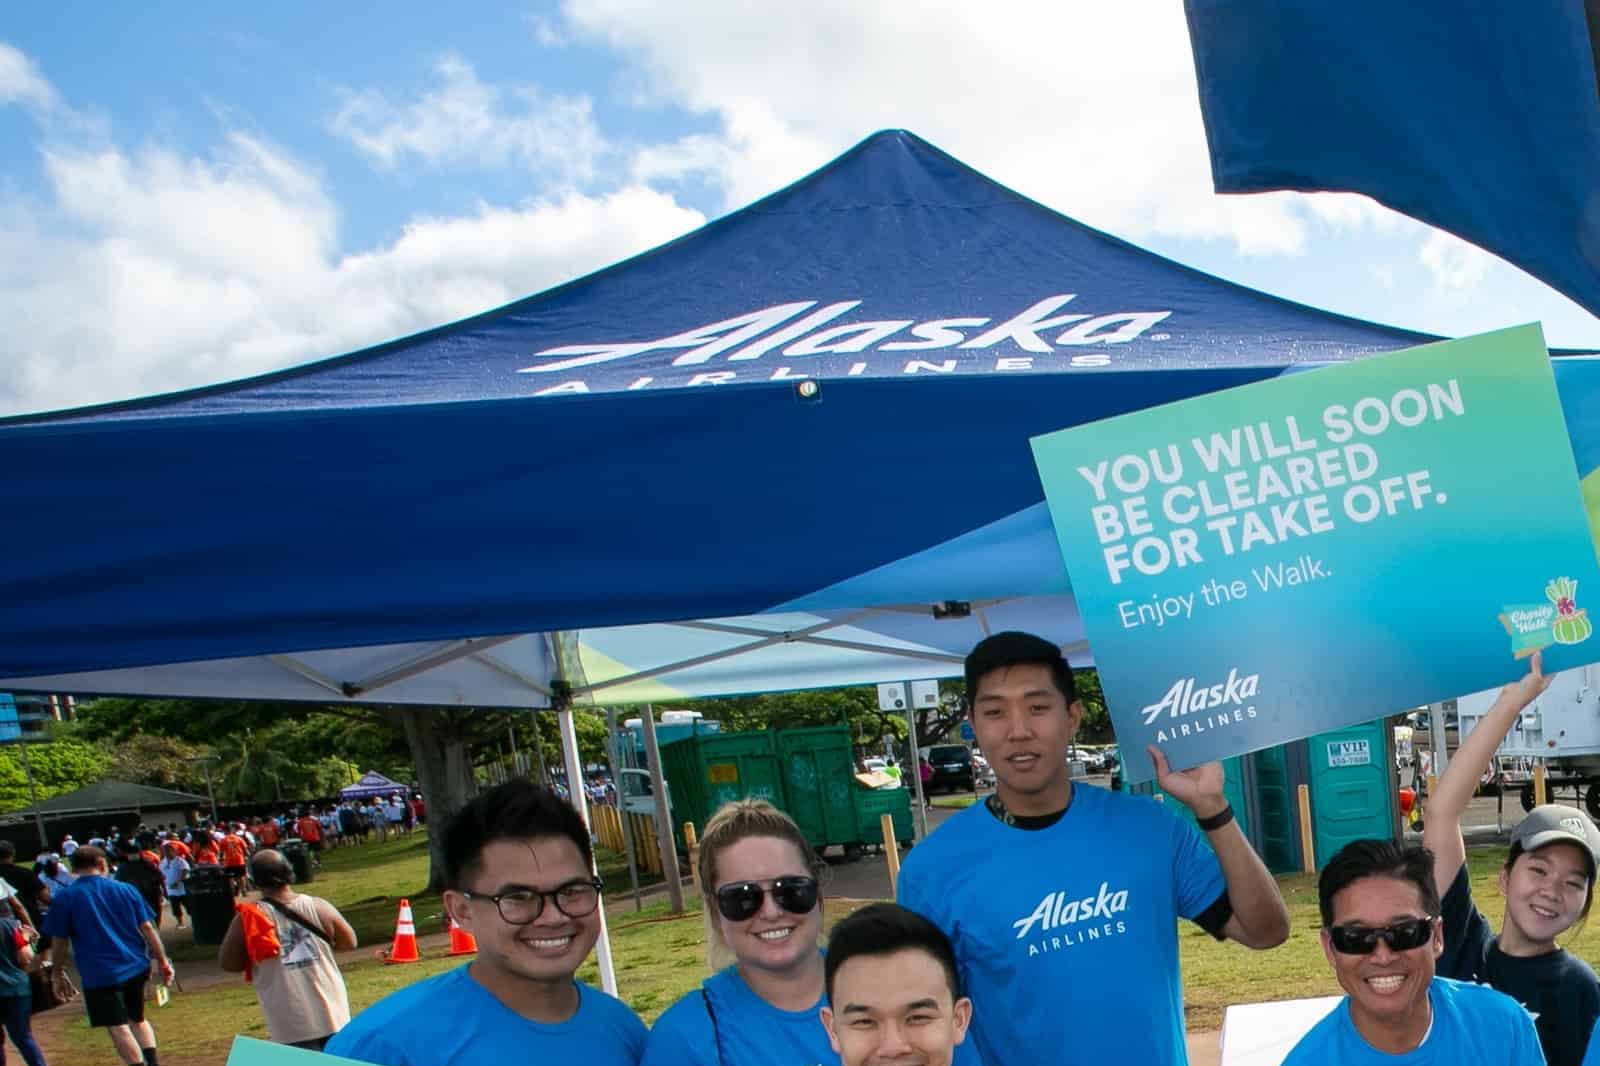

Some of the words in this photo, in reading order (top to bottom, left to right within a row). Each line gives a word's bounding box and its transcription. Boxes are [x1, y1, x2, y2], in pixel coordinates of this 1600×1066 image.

[516, 294, 1172, 373] Alaska
[533, 353, 1112, 397] AIRLINES
[1077, 444, 1183, 501] YOU
[1191, 415, 1316, 472] WILL
[1323, 379, 1465, 442] SOON
[1091, 496, 1153, 545] BE
[1162, 443, 1378, 524] CLEARED
[1103, 528, 1203, 585] FOR
[1206, 495, 1335, 556] TAKE
[1343, 469, 1447, 523] OFF.
[1117, 593, 1194, 629] Enjoy
[1200, 579, 1247, 606] the
[1252, 556, 1332, 592] Walk.
[1141, 668, 1259, 725] Alaska
[1157, 706, 1257, 743] AIRLINES
[1342, 741, 1367, 752] VIP
[1012, 881, 1129, 940] Alaska
[1029, 921, 1127, 957] AIRLINES
